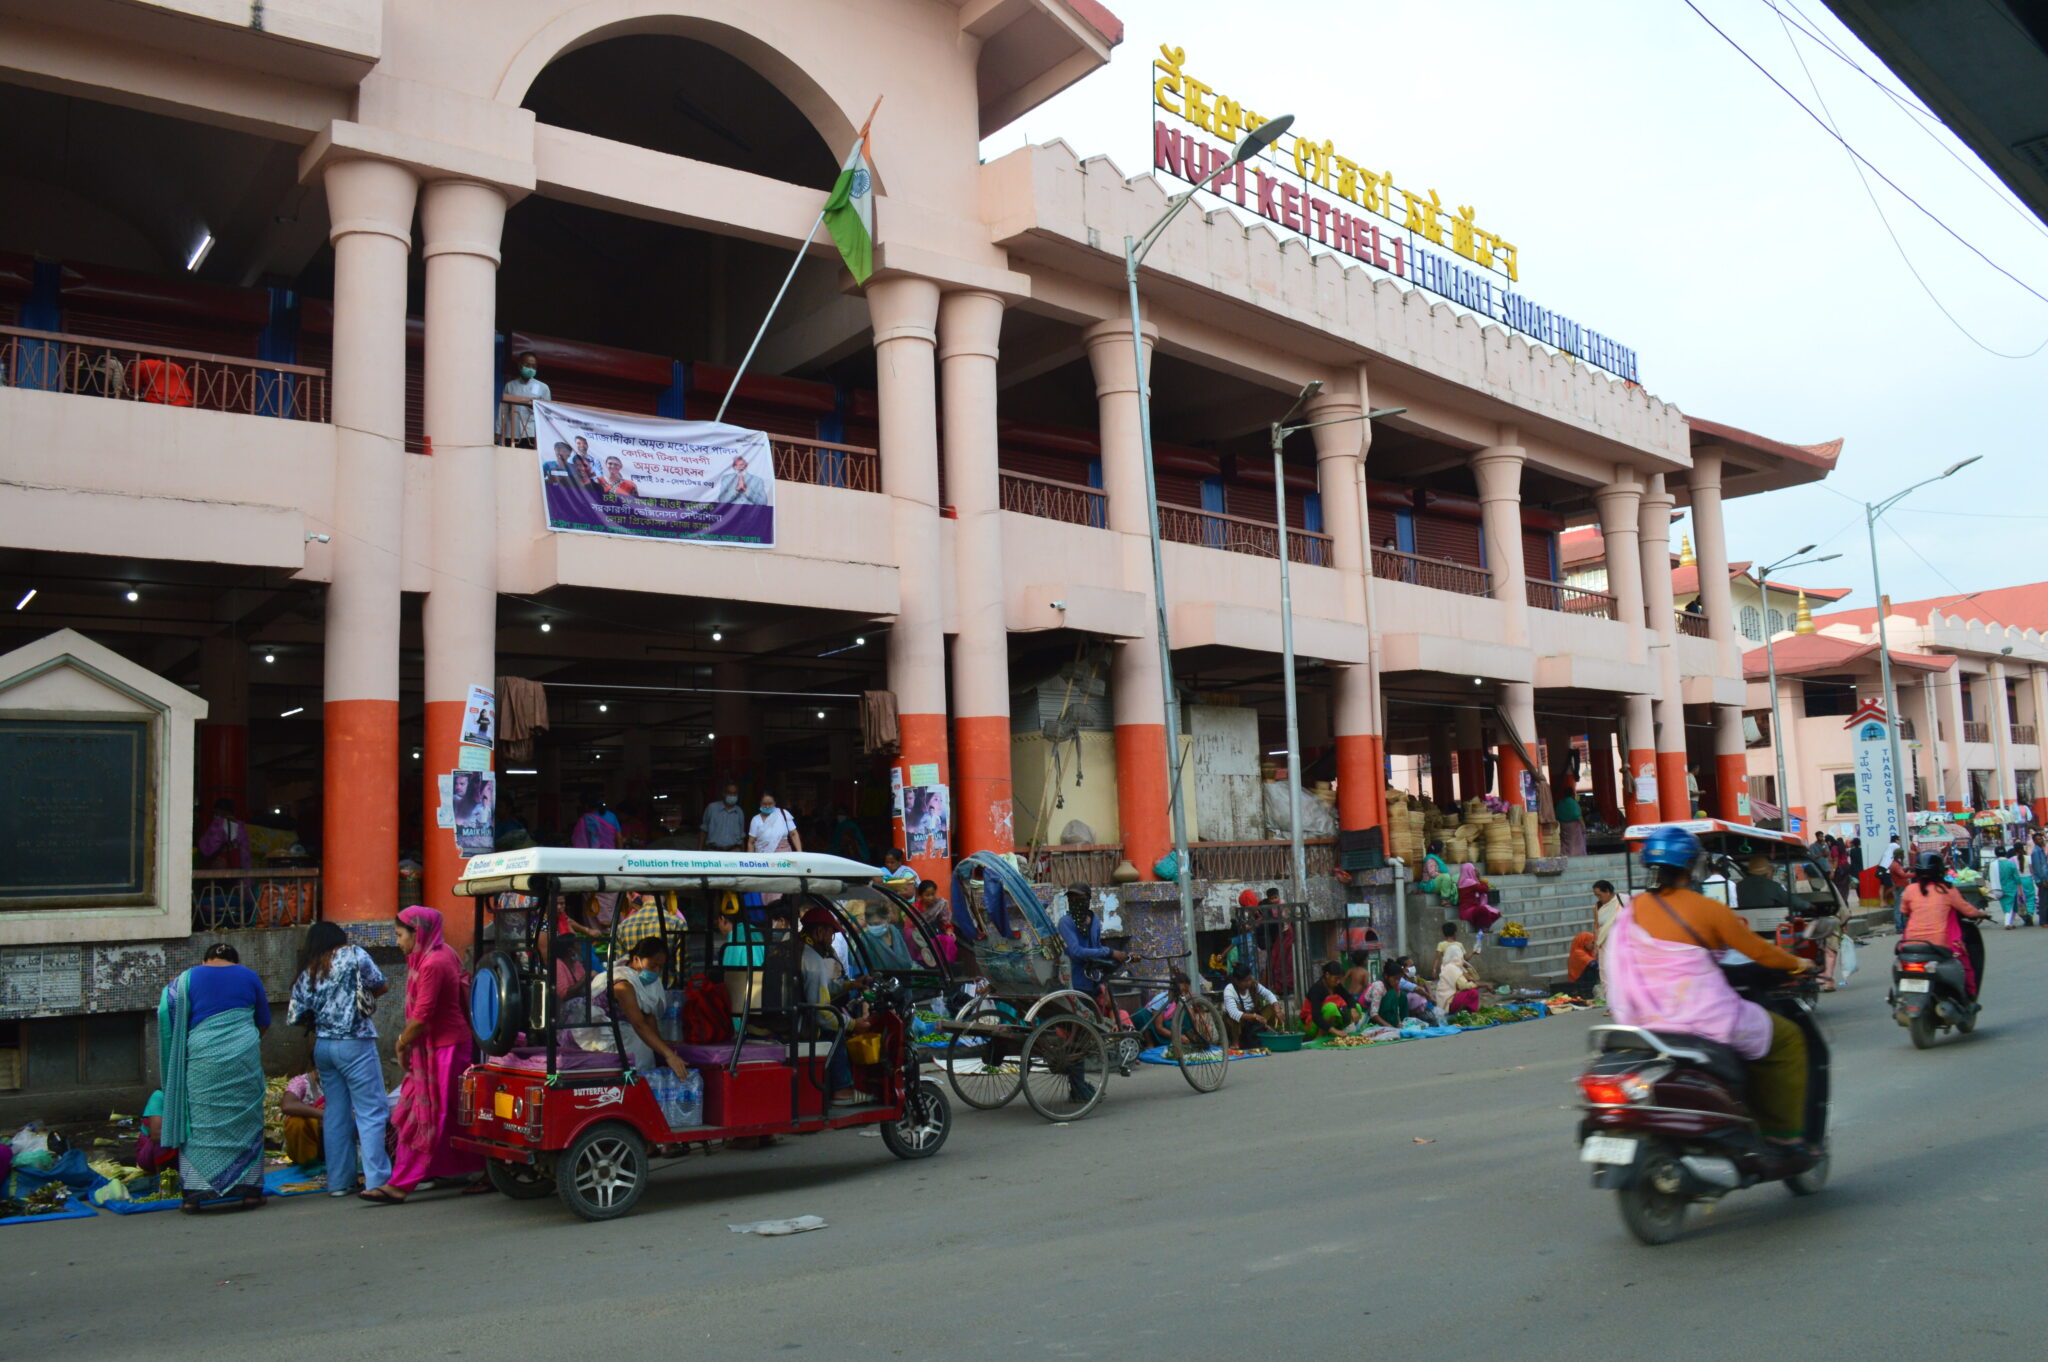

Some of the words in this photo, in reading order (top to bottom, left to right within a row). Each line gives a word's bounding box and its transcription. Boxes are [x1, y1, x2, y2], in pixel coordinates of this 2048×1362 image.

[1155, 120, 1246, 206] NUPI
[1257, 169, 1389, 271] KEITHEL
[1390, 237, 1405, 277] 1
[1409, 243, 1498, 319] LEIMAREL
[1502, 289, 1554, 346] SIDABI
[1557, 314, 1584, 359] IMA
[1587, 328, 1639, 384] KEITHEL
[639, 438, 664, 451] অমৃত
[633, 461, 660, 474] অমৃত
[662, 464, 705, 477] মহোৎসব
[1882, 748, 1894, 803] THANGAL
[627, 859, 669, 868] Pollution
[671, 859, 689, 868] free
[691, 859, 722, 869] Imphal
[573, 1087, 608, 1096] BUTTERFLY
